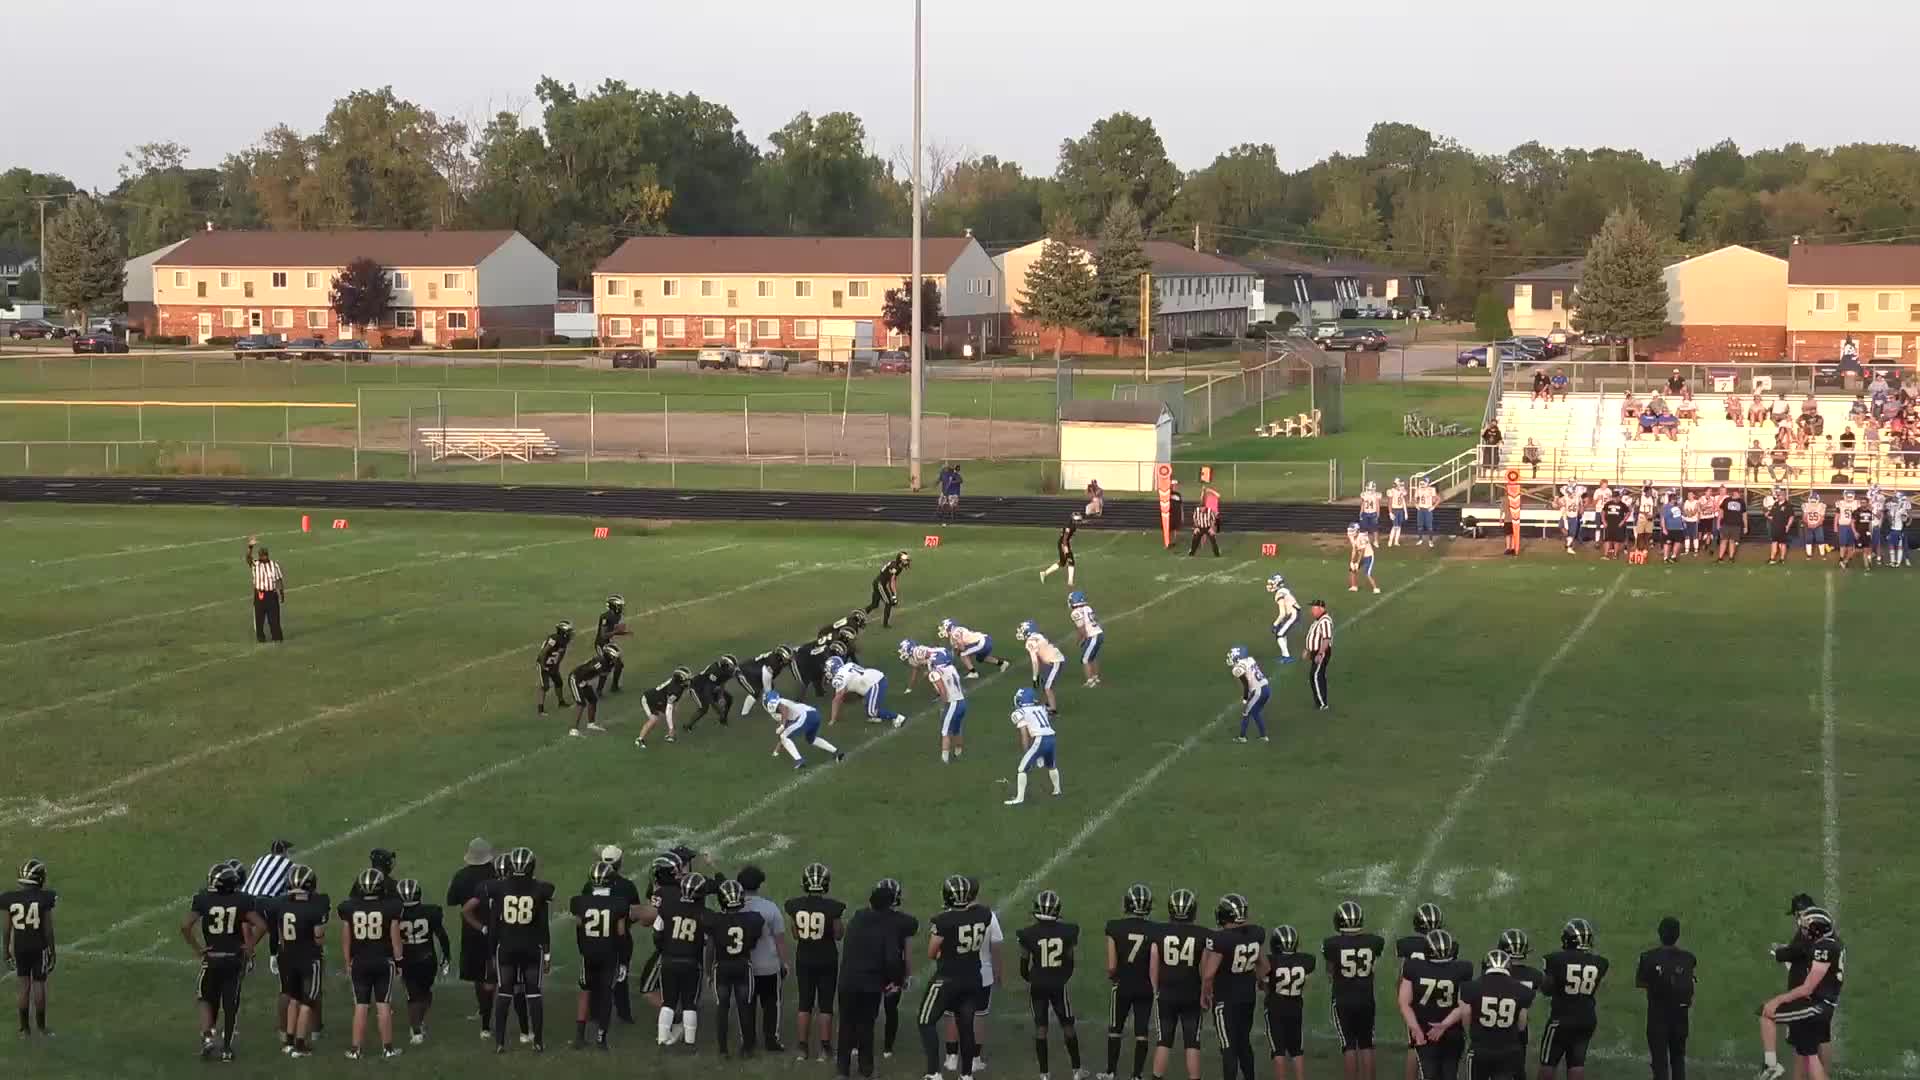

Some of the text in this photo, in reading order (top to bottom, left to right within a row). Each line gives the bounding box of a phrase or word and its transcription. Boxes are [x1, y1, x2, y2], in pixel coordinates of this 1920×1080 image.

[10, 902, 41, 930] 24
[208, 905, 237, 935] 31
[503, 895, 534, 925] 68
[584, 908, 611, 938] 21
[282, 913, 296, 941] 6
[352, 911, 383, 940] 88
[672, 916, 697, 942] 18
[727, 926, 744, 955] 3
[795, 910, 825, 941] 99
[1037, 937, 1063, 968] 12
[1127, 933, 1144, 963] 7
[1162, 935, 1195, 967] 64
[1231, 941, 1260, 974] 62
[1340, 948, 1374, 978] 53
[1814, 949, 1829, 961] 54
[1275, 966, 1305, 996] 22
[1419, 976, 1455, 1008] 73
[1564, 963, 1598, 996] 58
[1479, 996, 1517, 1029] 59
